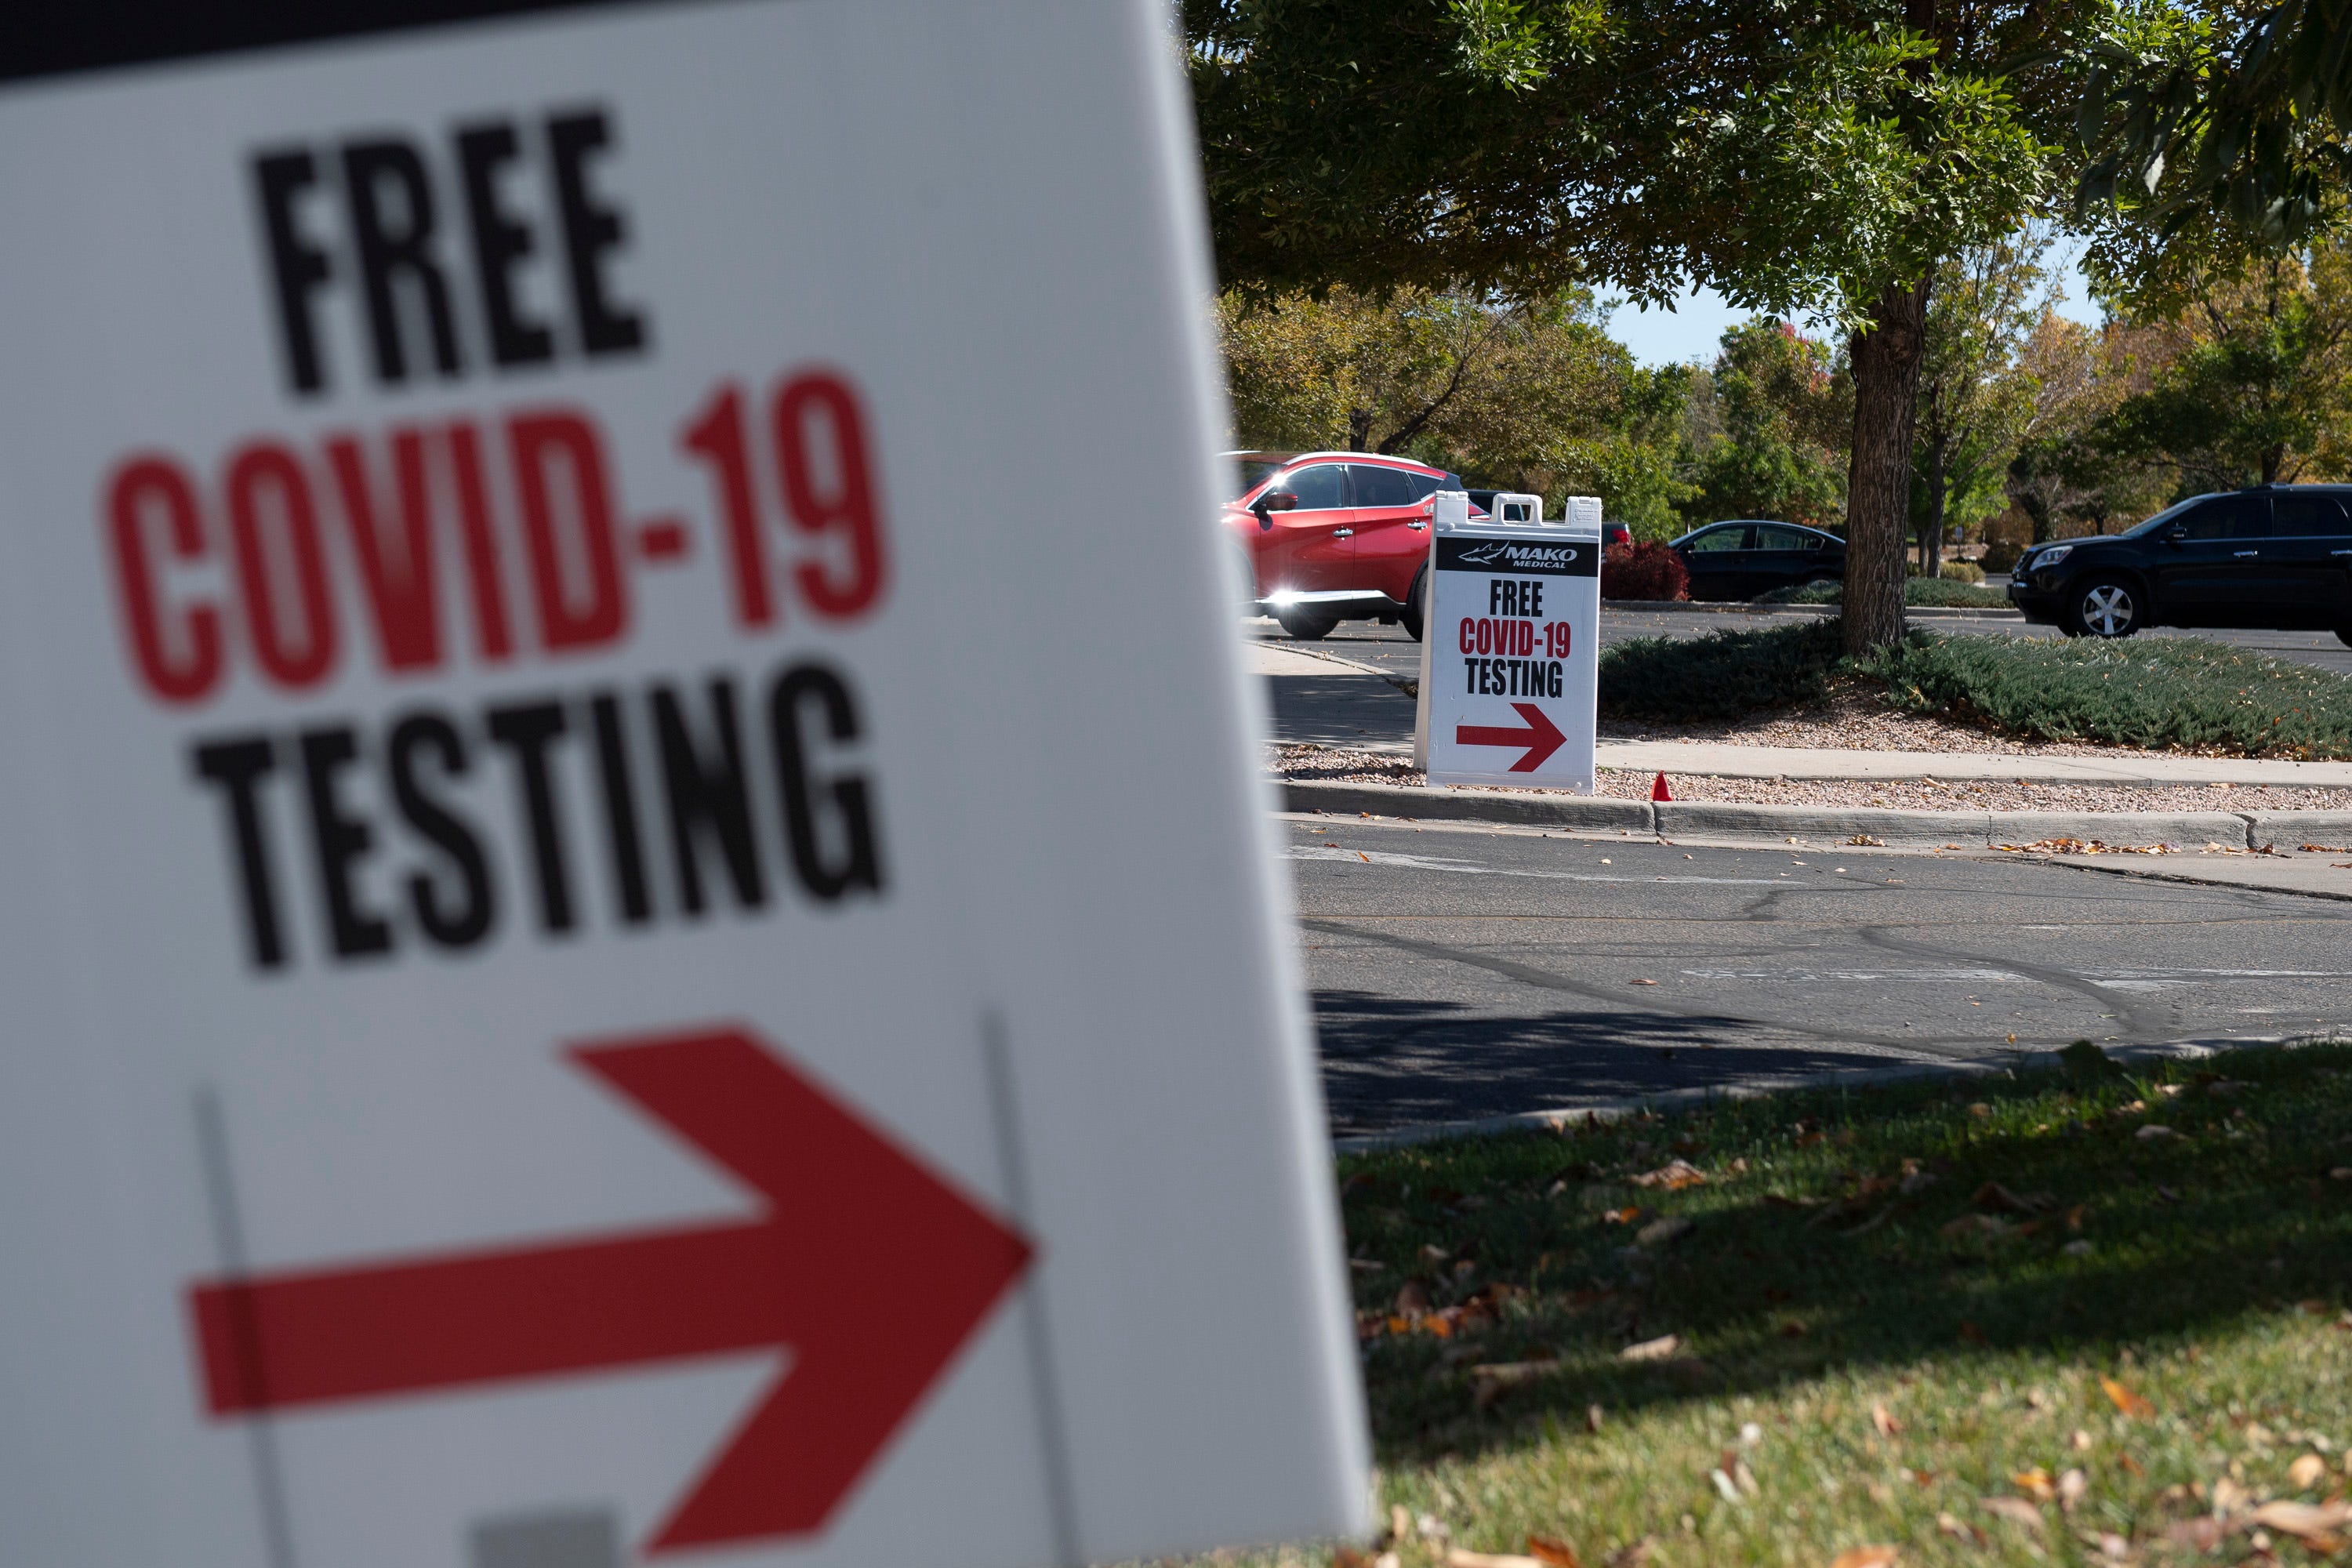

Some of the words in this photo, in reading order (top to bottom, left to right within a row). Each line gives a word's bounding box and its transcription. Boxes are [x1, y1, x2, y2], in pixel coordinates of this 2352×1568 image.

[246, 102, 655, 401] FREE
[102, 361, 891, 707] COVID-19
[1505, 546, 1577, 561] MAKO
[1513, 561, 1566, 569] MEDICAL
[1490, 580, 1543, 616] FREE
[1459, 617, 1571, 659] COVID-19
[1465, 659, 1563, 698] TESTING
[191, 655, 887, 975] TESTING
